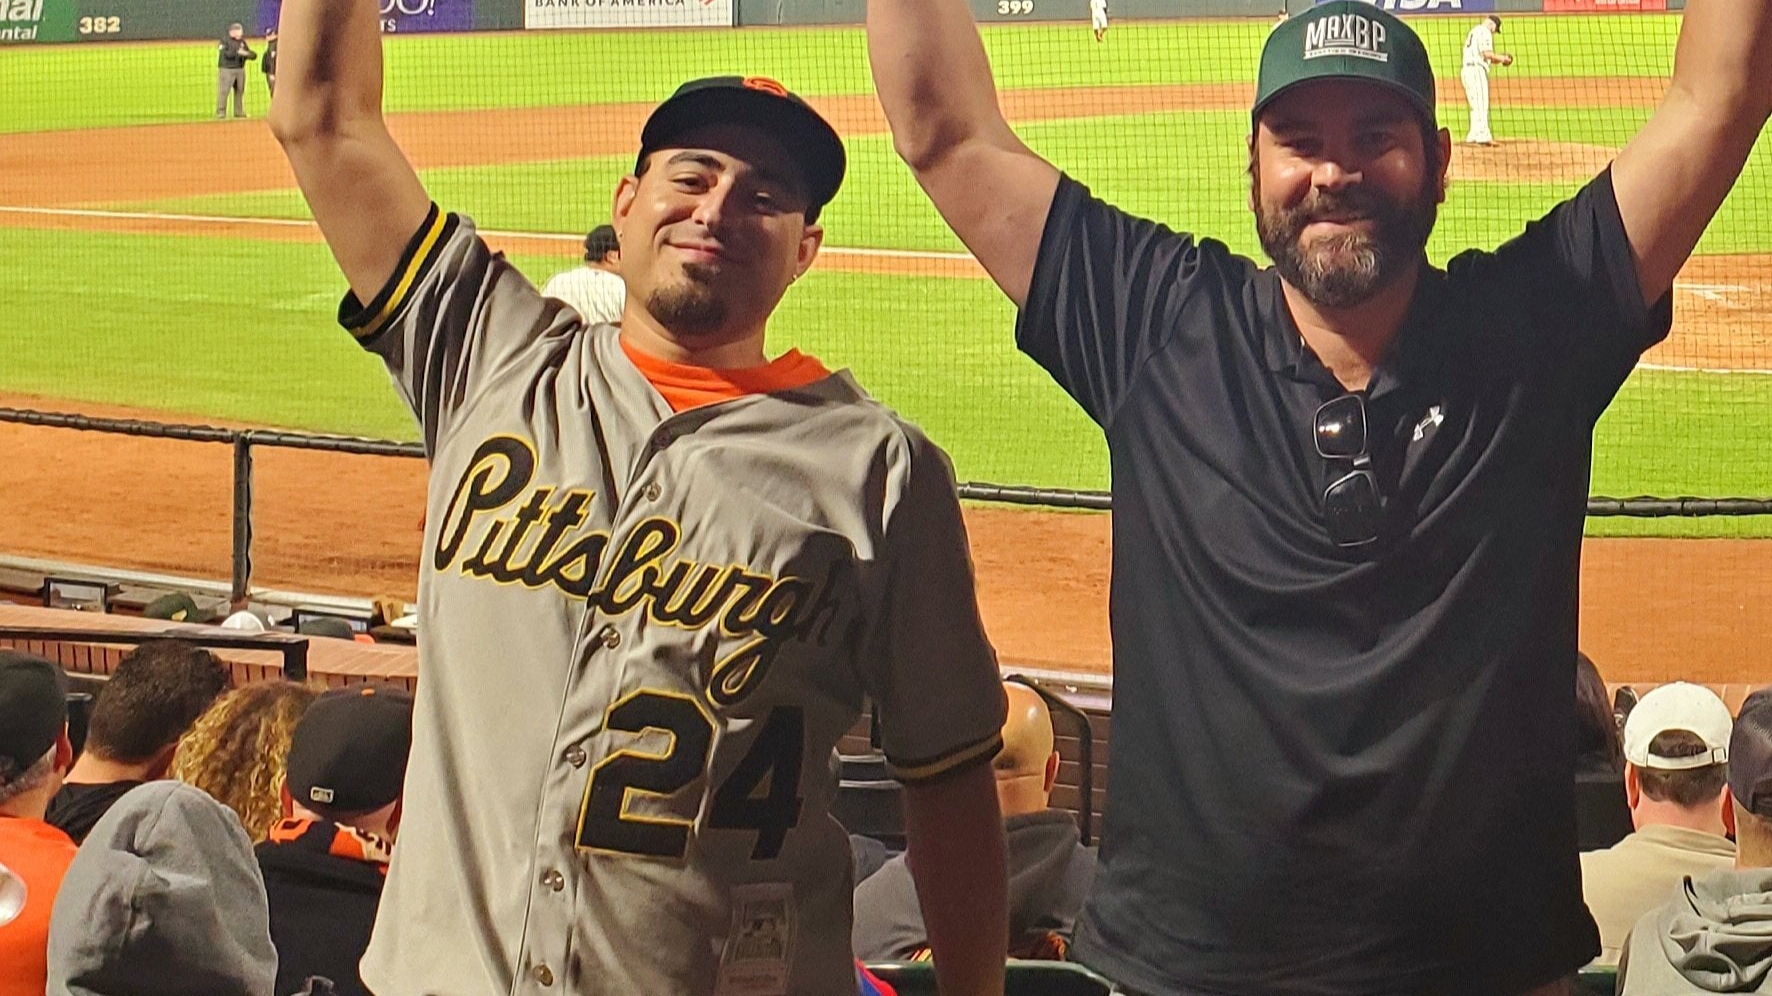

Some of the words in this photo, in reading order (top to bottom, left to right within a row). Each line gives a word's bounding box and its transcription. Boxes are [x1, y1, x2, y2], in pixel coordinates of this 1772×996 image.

[998, 0, 1034, 15] 399
[79, 16, 121, 34] 382
[1305, 13, 1386, 52] MAXBP
[574, 688, 806, 862] 24
